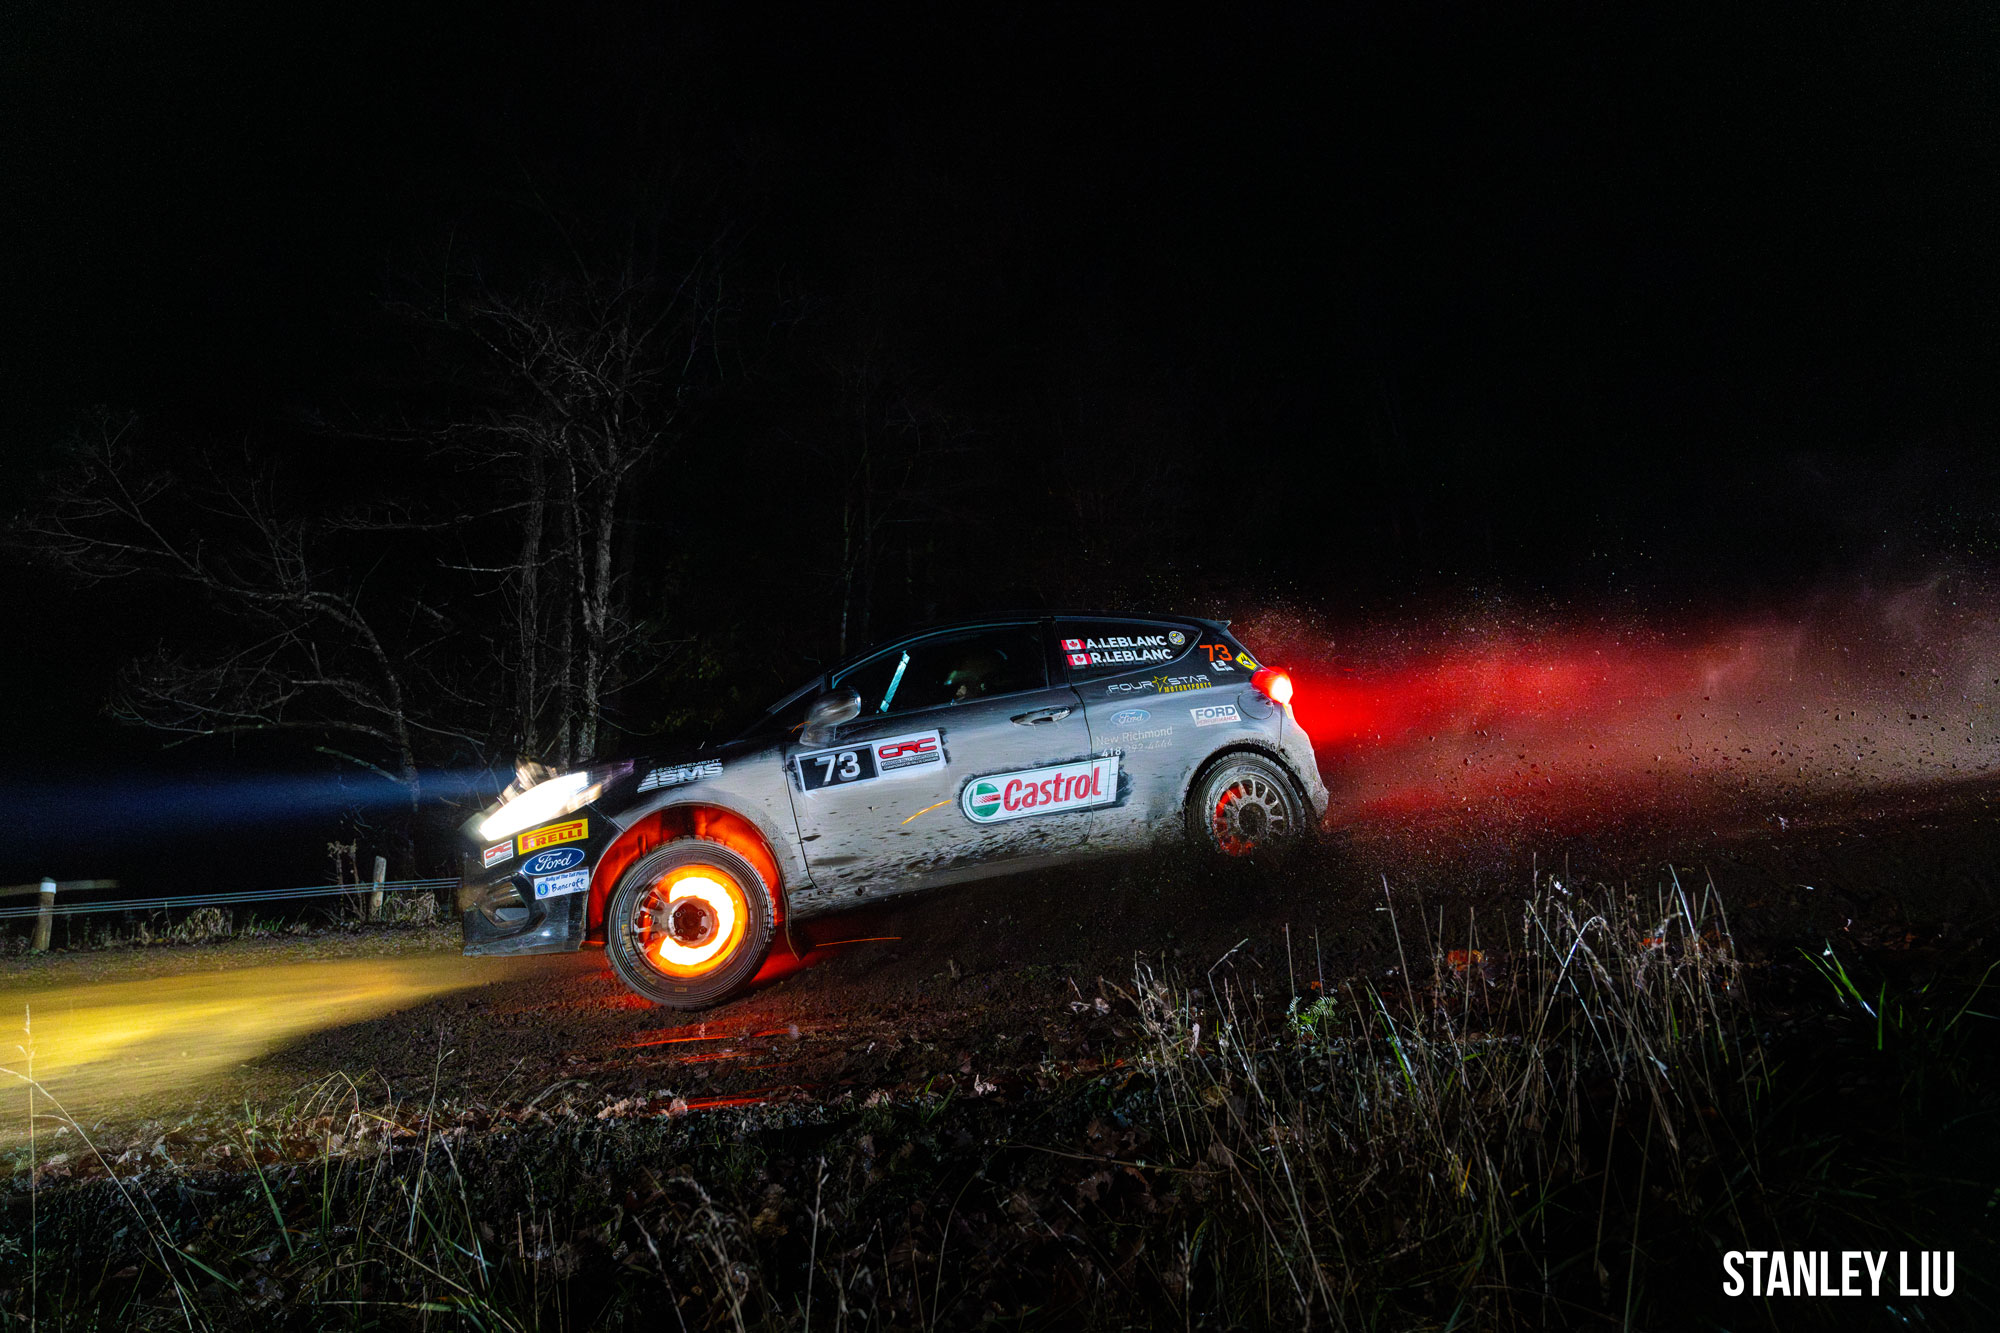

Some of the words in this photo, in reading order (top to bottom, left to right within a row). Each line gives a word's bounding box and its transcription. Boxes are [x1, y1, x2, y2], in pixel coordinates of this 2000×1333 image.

[1086, 635, 1168, 649] A.LEBLANC
[1089, 648, 1173, 664] R.LEBLANC
[1199, 644, 1233, 662] 73
[1107, 680, 1154, 693] FOUR
[1167, 674, 1210, 686] STAR
[1163, 681, 1212, 694] MOTORSPORTS
[1195, 706, 1236, 720] FORD
[1095, 735, 1119, 746] New
[1122, 726, 1173, 742] Richmond
[878, 737, 938, 759] CRC
[1101, 746, 1122, 757] 418
[816, 751, 860, 782] 73
[1003, 766, 1102, 812] Castrol
[521, 822, 583, 851] PIRELLI
[534, 851, 573, 872] Ford
[551, 878, 585, 892] Bancroft
